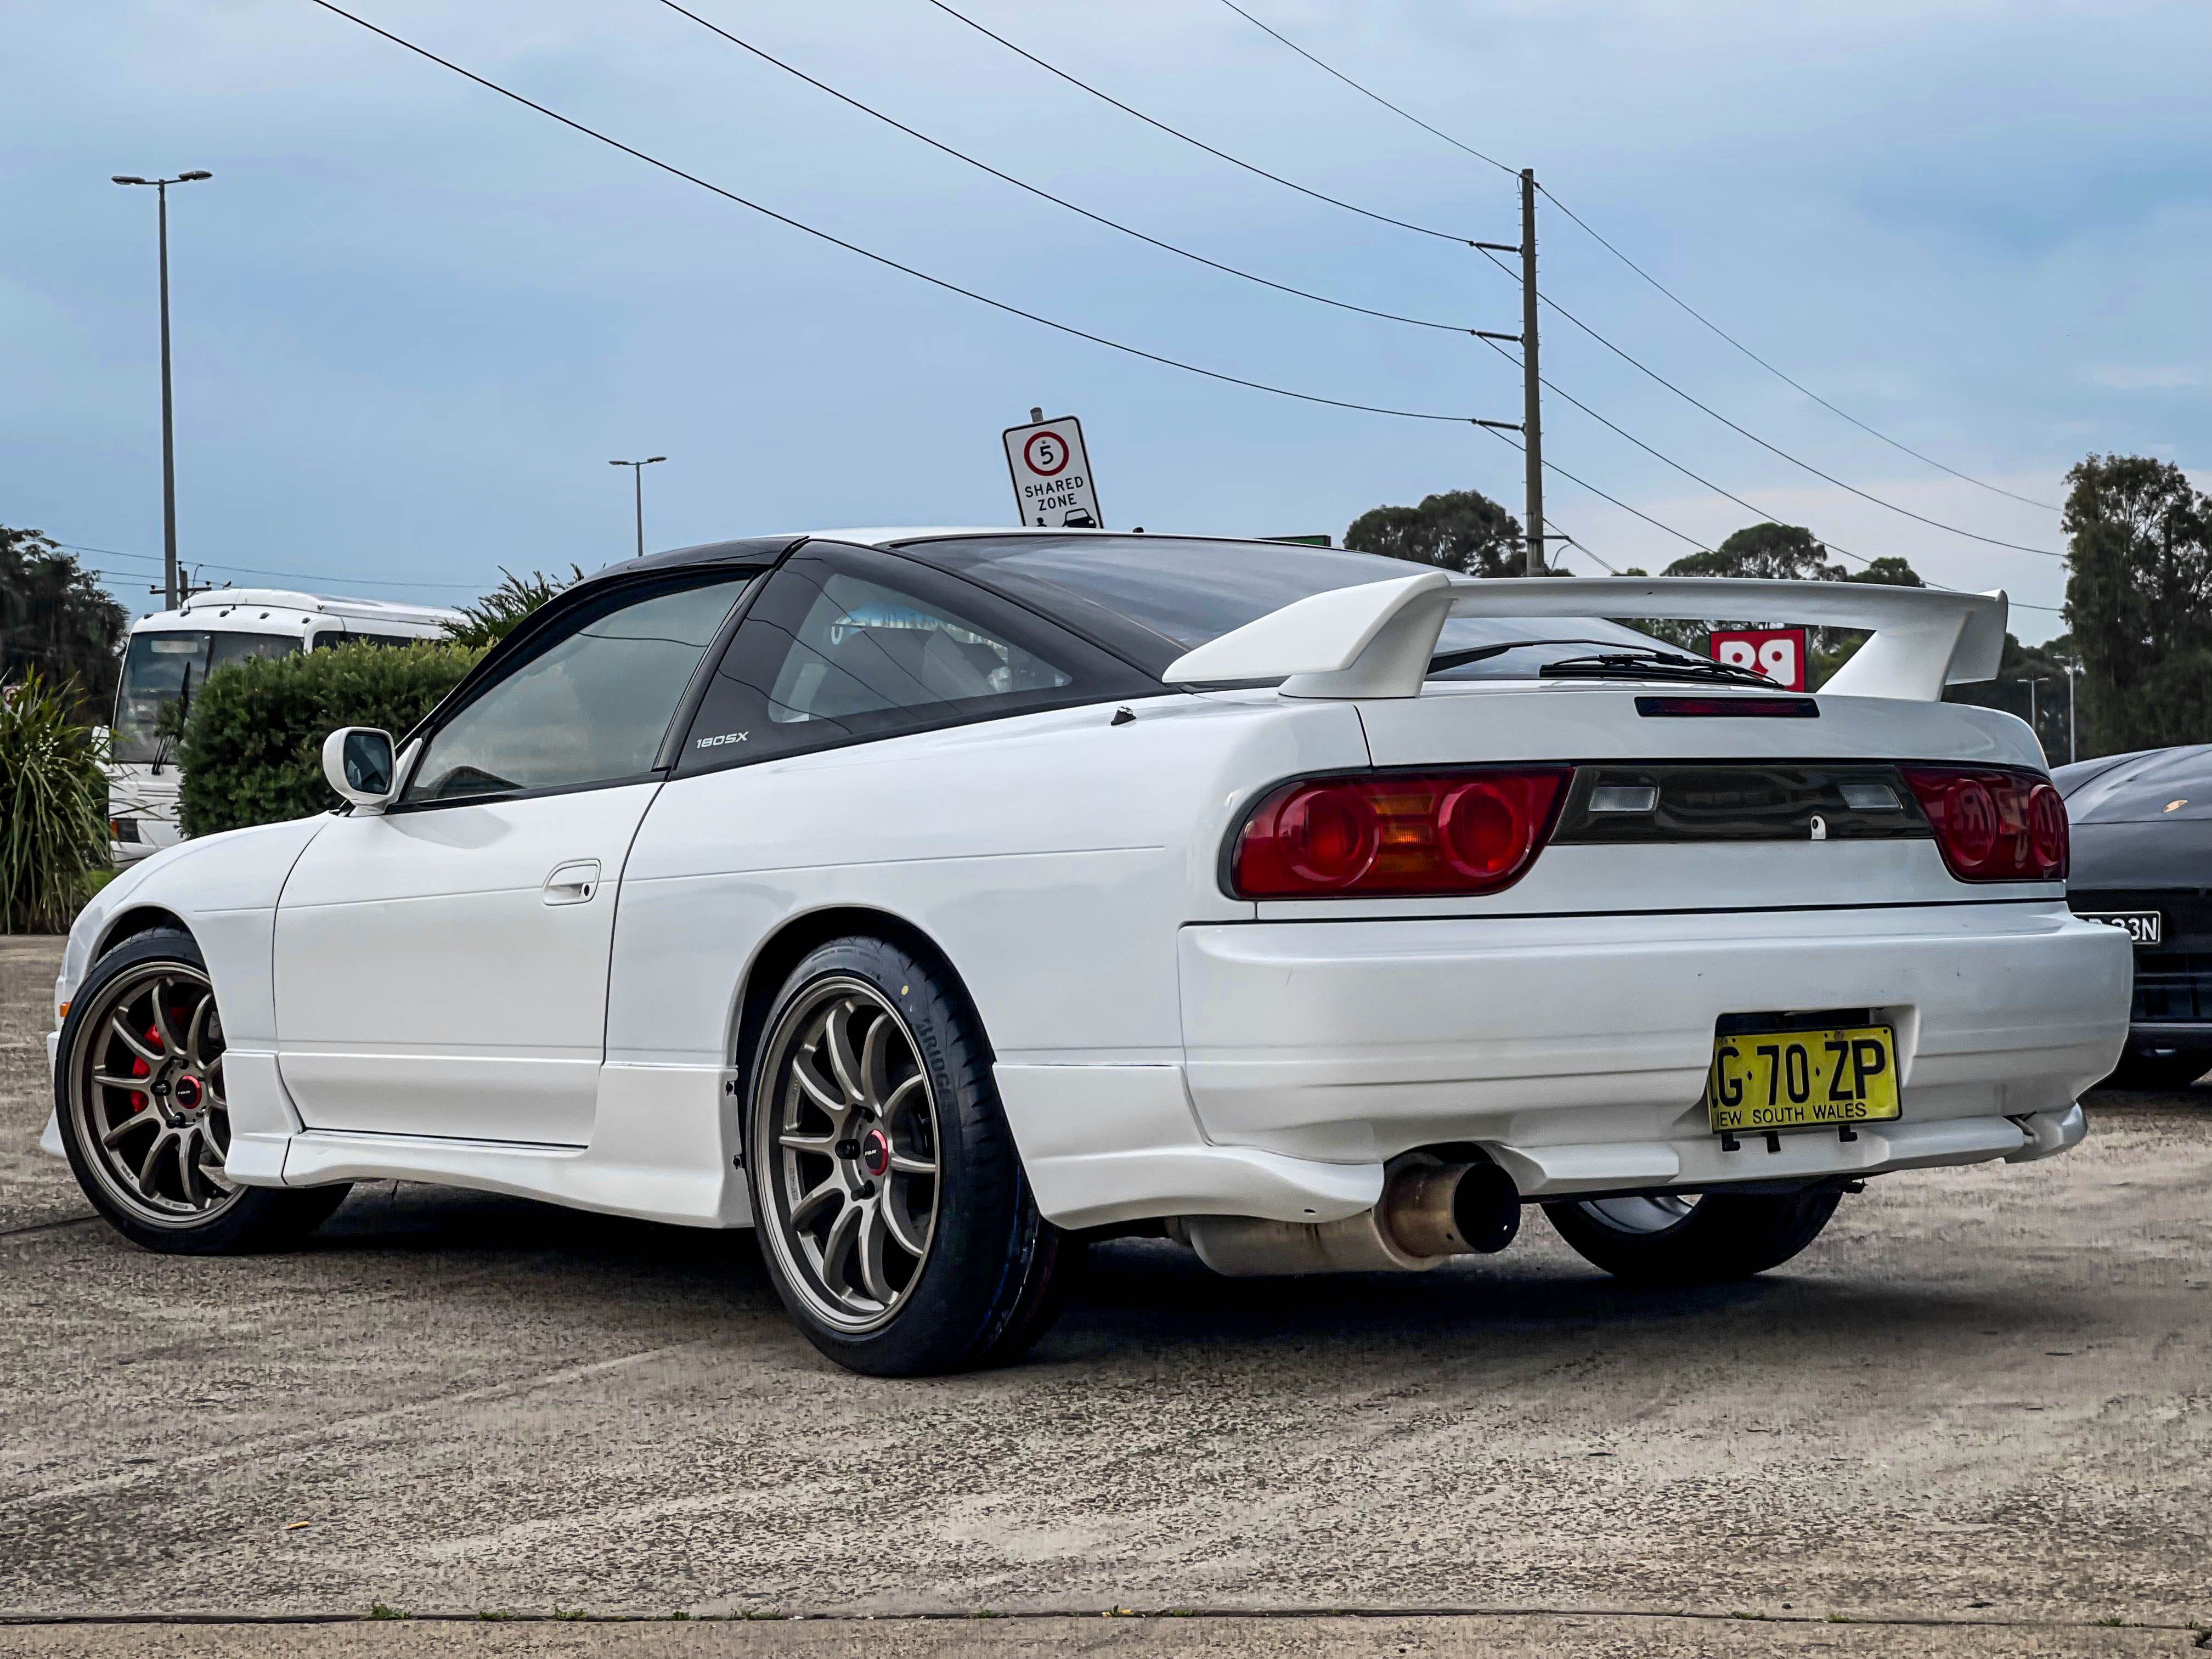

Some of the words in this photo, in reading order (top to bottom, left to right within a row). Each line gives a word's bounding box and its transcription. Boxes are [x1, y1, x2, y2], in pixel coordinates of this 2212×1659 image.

[1039, 445, 1054, 465] 5
[1024, 476, 1084, 498] SHARED
[1037, 493, 1077, 511] ZONE
[696, 731, 749, 749] 180SX
[1709, 1046, 1744, 1108] G
[1717, 1110, 1742, 1127] EW
[1752, 1107, 1805, 1124] SOUTH
[1812, 1102, 1867, 1120] WALES
